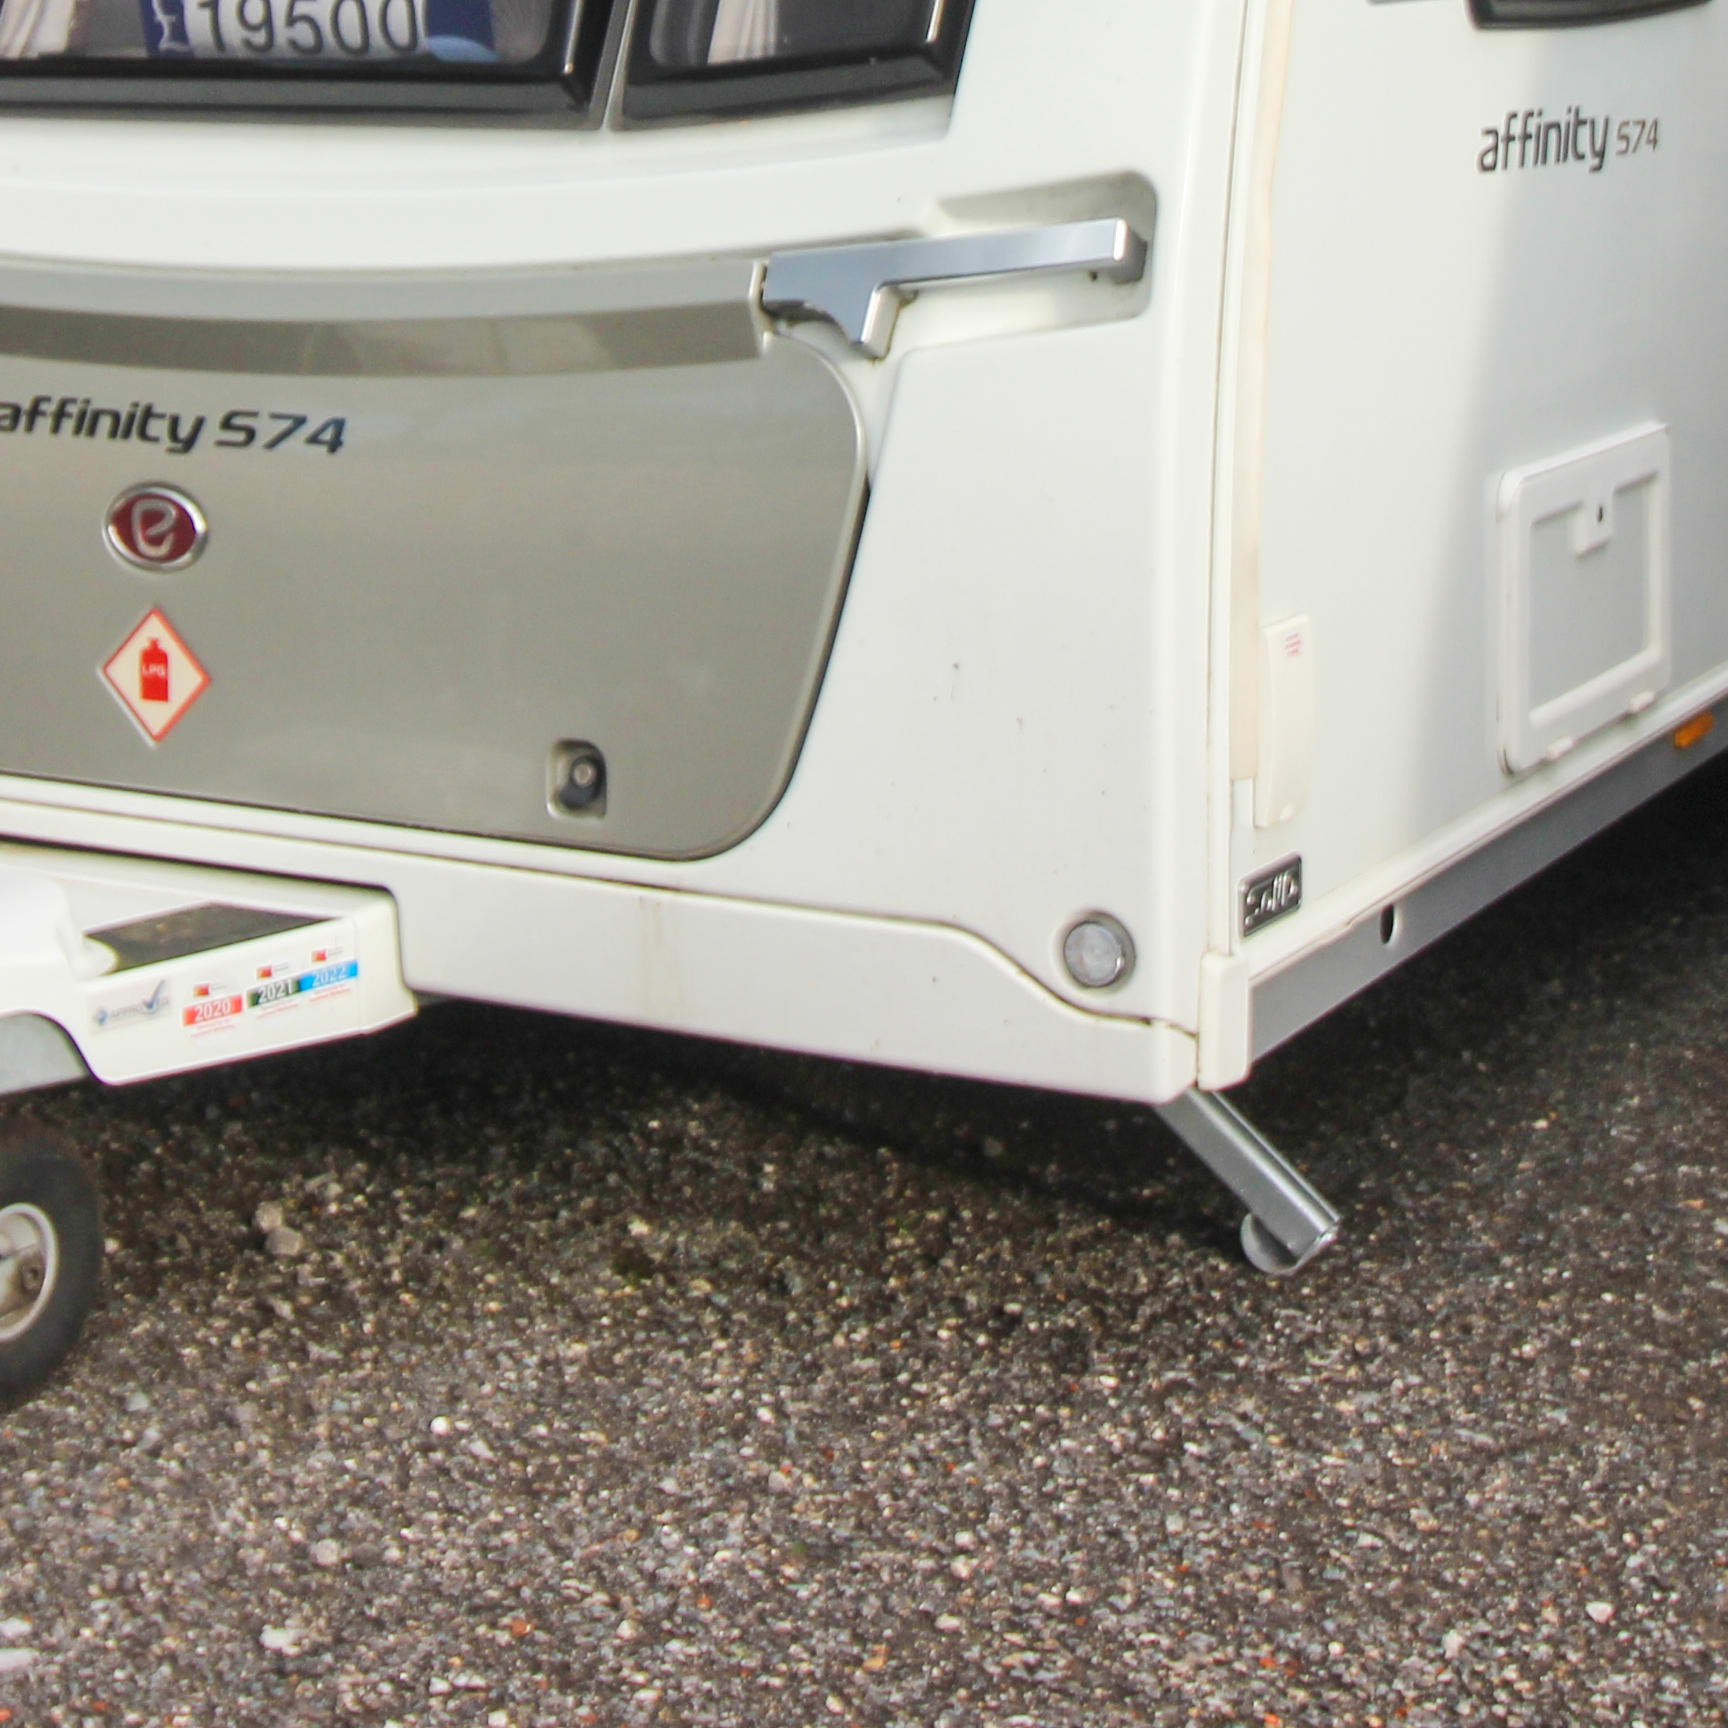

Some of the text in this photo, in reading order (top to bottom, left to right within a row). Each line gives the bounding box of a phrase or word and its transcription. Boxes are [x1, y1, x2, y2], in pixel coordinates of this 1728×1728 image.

[1477, 105, 1660, 173] affinity 574
[215, 408, 347, 454] 574
[312, 964, 347, 989] 2022
[257, 978, 293, 1004] 2021
[194, 998, 232, 1022] 2020
